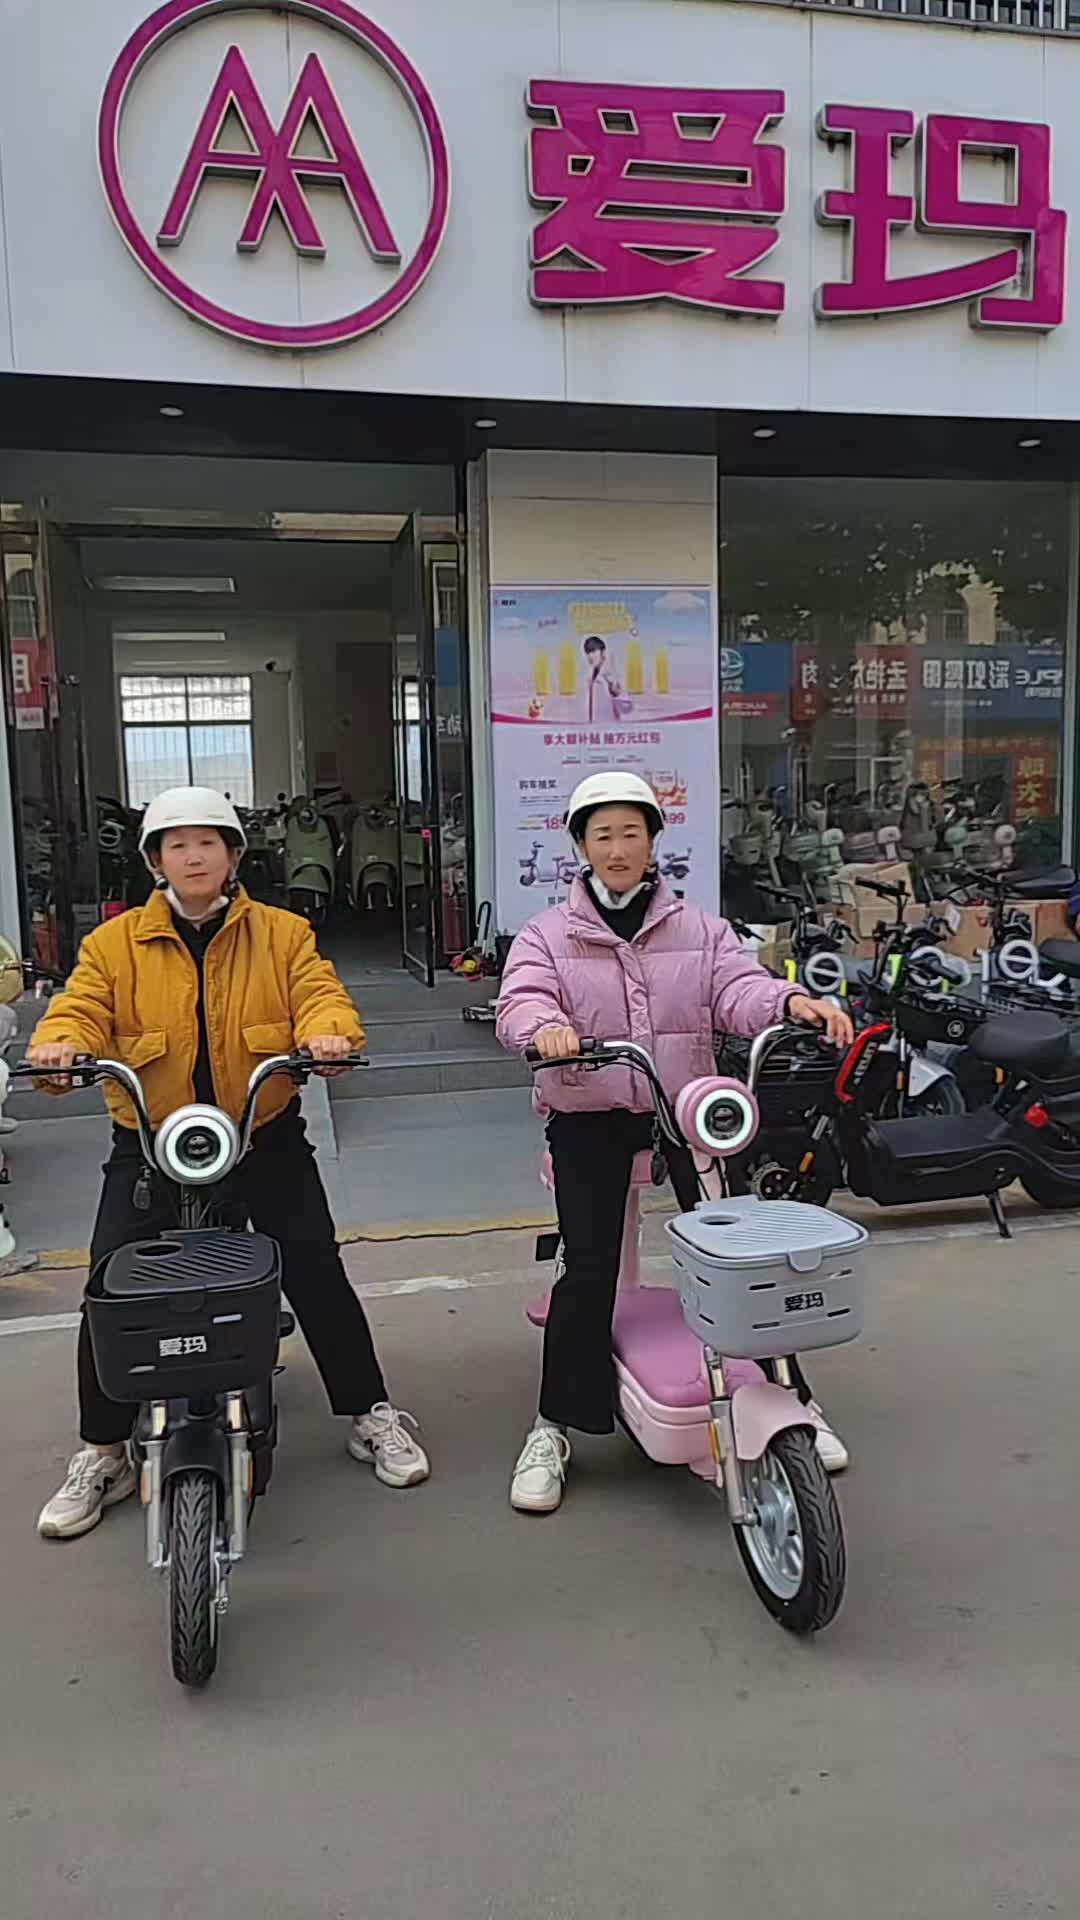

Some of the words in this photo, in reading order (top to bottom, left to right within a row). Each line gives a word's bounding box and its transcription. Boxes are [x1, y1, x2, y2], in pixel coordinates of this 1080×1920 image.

[526, 78, 1068, 333] 爱玛
[784, 1291, 824, 1312] 爱玛
[159, 1336, 208, 1356] 爱玛
